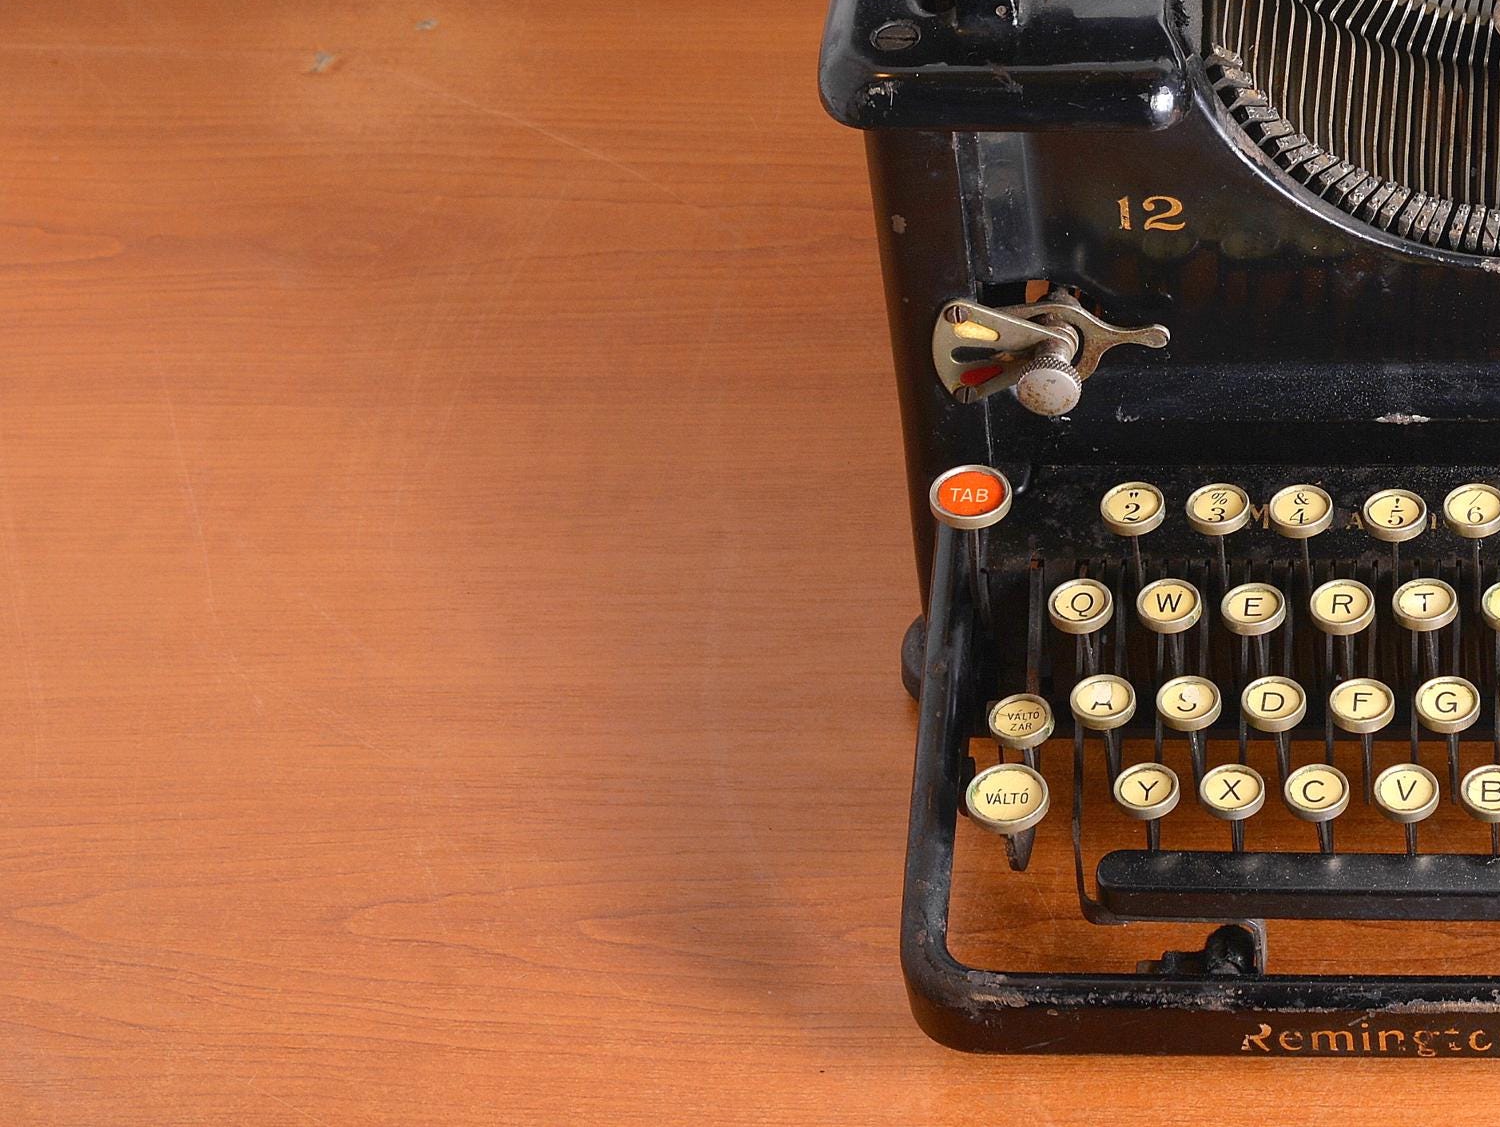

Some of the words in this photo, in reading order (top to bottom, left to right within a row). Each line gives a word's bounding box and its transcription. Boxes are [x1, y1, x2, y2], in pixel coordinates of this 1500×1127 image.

[1117, 195, 1186, 231] 12
[949, 486, 990, 504] TAB
[1123, 502, 1140, 523] 2
[1207, 507, 1225, 522] 3
[1289, 508, 1309, 525] 4
[1387, 509, 1405, 525] 5
[1466, 506, 1485, 524] 6
[1071, 593, 1093, 617] Q
[1157, 594, 1182, 612] W
[1244, 598, 1263, 616] E
[1332, 594, 1353, 614] R
[1415, 593, 1434, 611] T
[1261, 692, 1285, 713] D
[1353, 693, 1372, 711] F
[1435, 692, 1458, 713] G
[984, 786, 1030, 804] VÁLTÓ
[1138, 781, 1159, 801] Y
[1220, 780, 1241, 800] X
[1303, 780, 1325, 802] C
[1397, 780, 1417, 801] V
